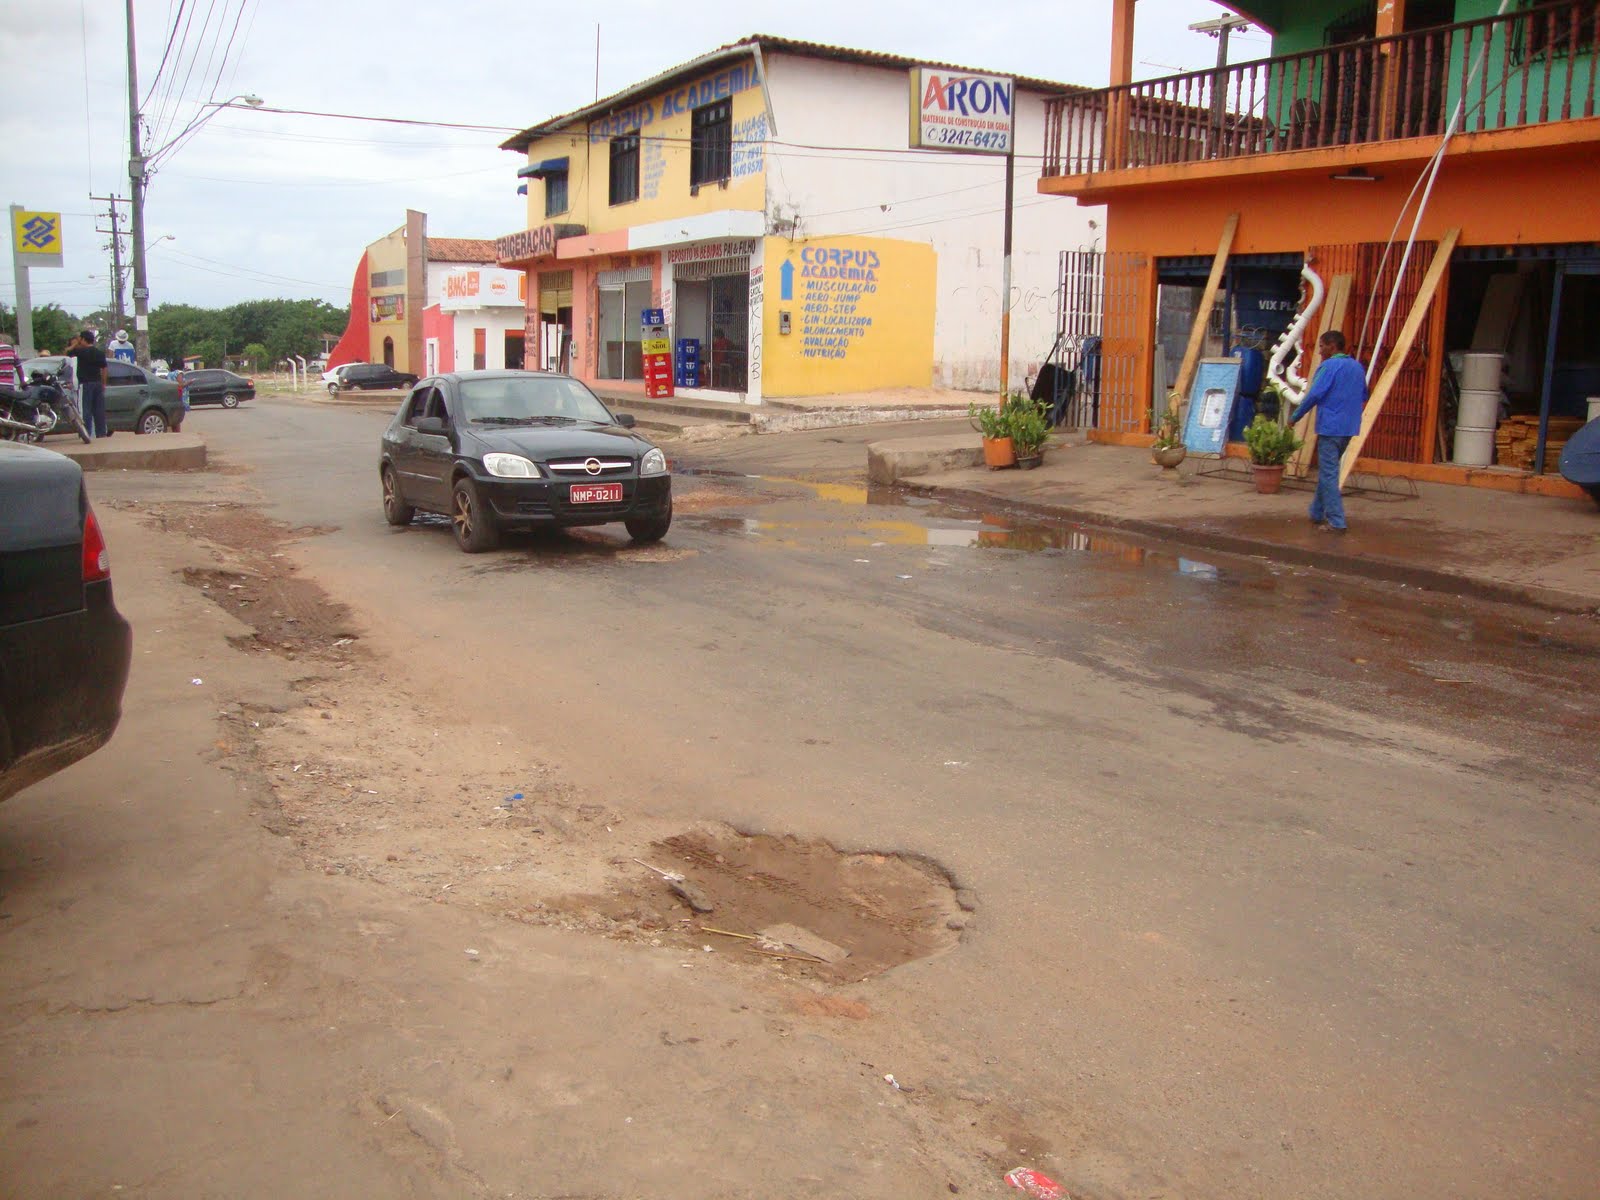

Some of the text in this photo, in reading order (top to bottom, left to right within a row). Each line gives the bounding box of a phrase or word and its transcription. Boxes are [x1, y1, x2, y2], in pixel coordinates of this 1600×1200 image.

[922, 113, 946, 125] MATERIAL
[948, 116, 954, 126] DE
[955, 117, 986, 130] CONSTRUÇÃO
[996, 121, 1010, 131] GERAL
[938, 127, 1007, 149] 3247-6473
[801, 247, 880, 268] CORPUS
[806, 280, 877, 294] MUSCULAÇÃO
[804, 303, 857, 314] AERO-STEP
[1259, 299, 1278, 310] VIX
[803, 348, 846, 360] NUTRIÇÃO
